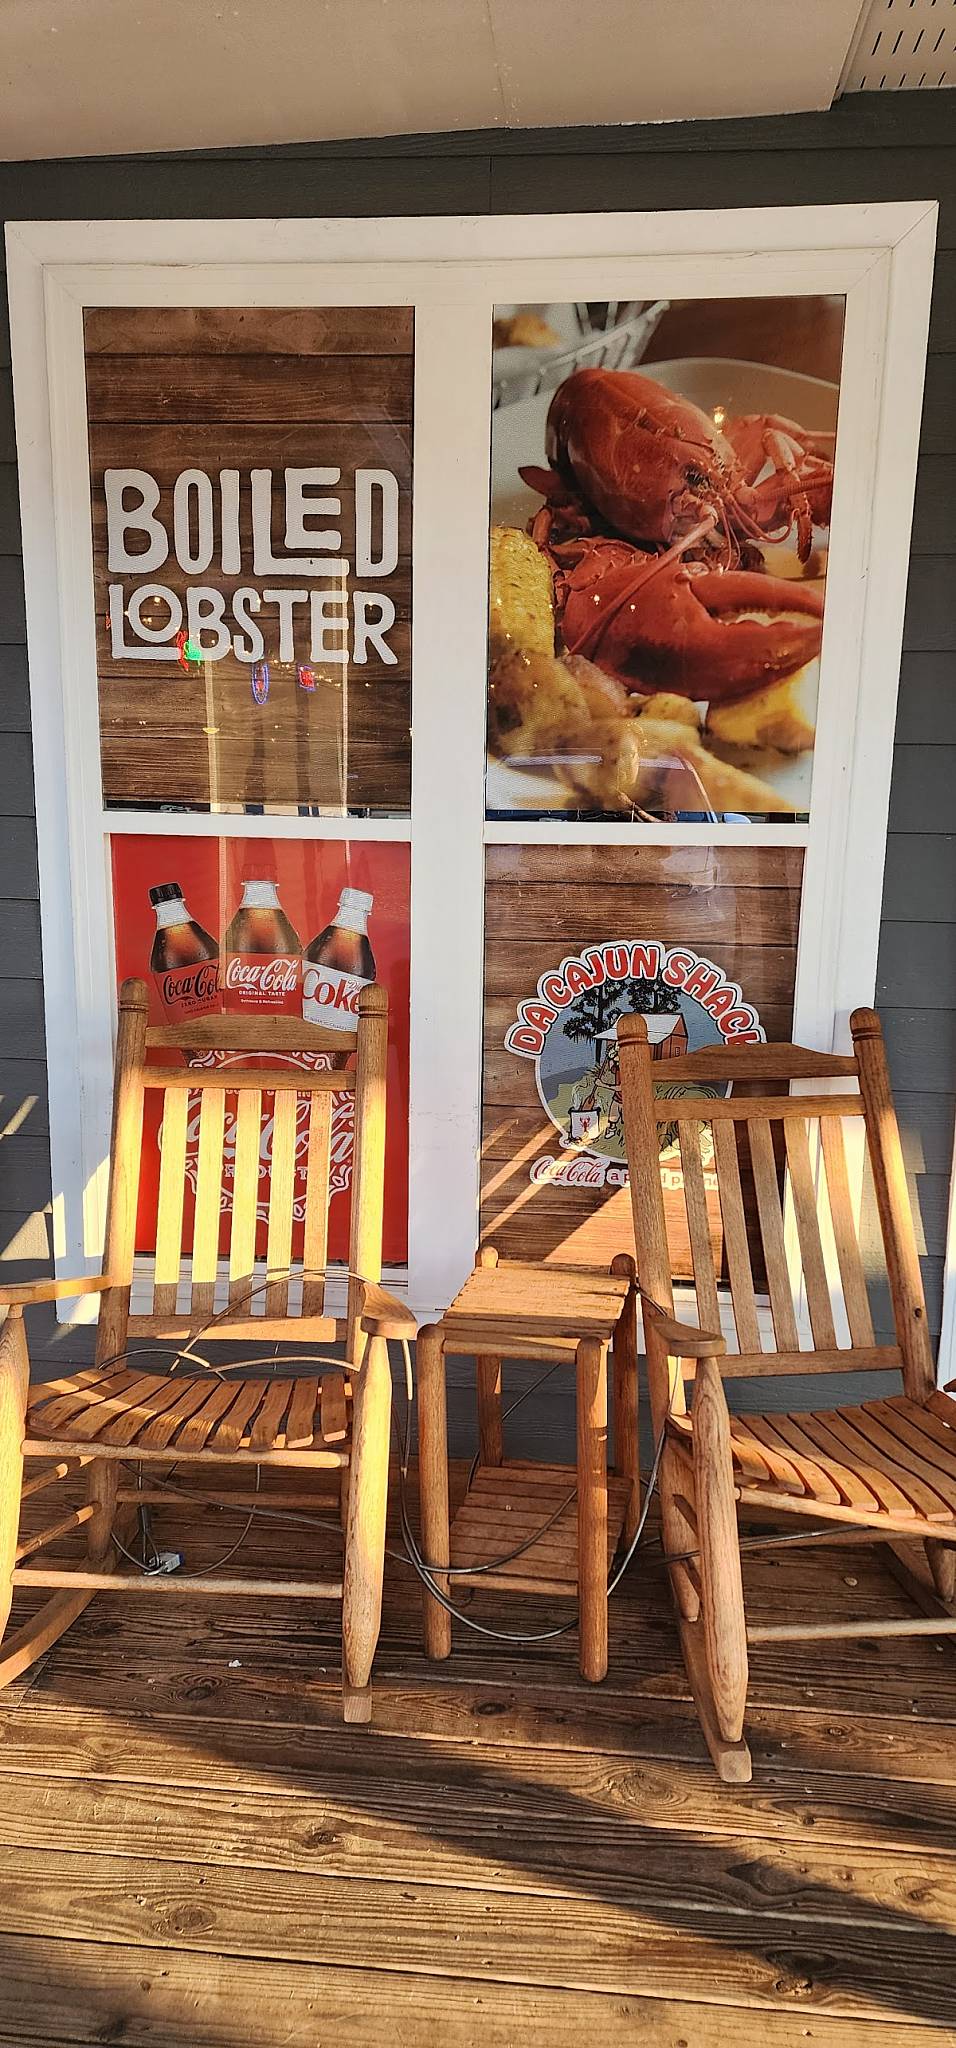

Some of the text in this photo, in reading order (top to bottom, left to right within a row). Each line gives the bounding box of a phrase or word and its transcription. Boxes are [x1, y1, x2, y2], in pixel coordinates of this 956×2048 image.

[104, 467, 400, 577] BOILED
[108, 583, 399, 664] LOBSTER
[163, 965, 221, 1005] Coca-Col
[226, 957, 298, 991] Coca-Cola
[509, 1002, 557, 1055] DA
[542, 944, 661, 1007] CAJUN
[533, 1158, 602, 1184] Coca-Cola
